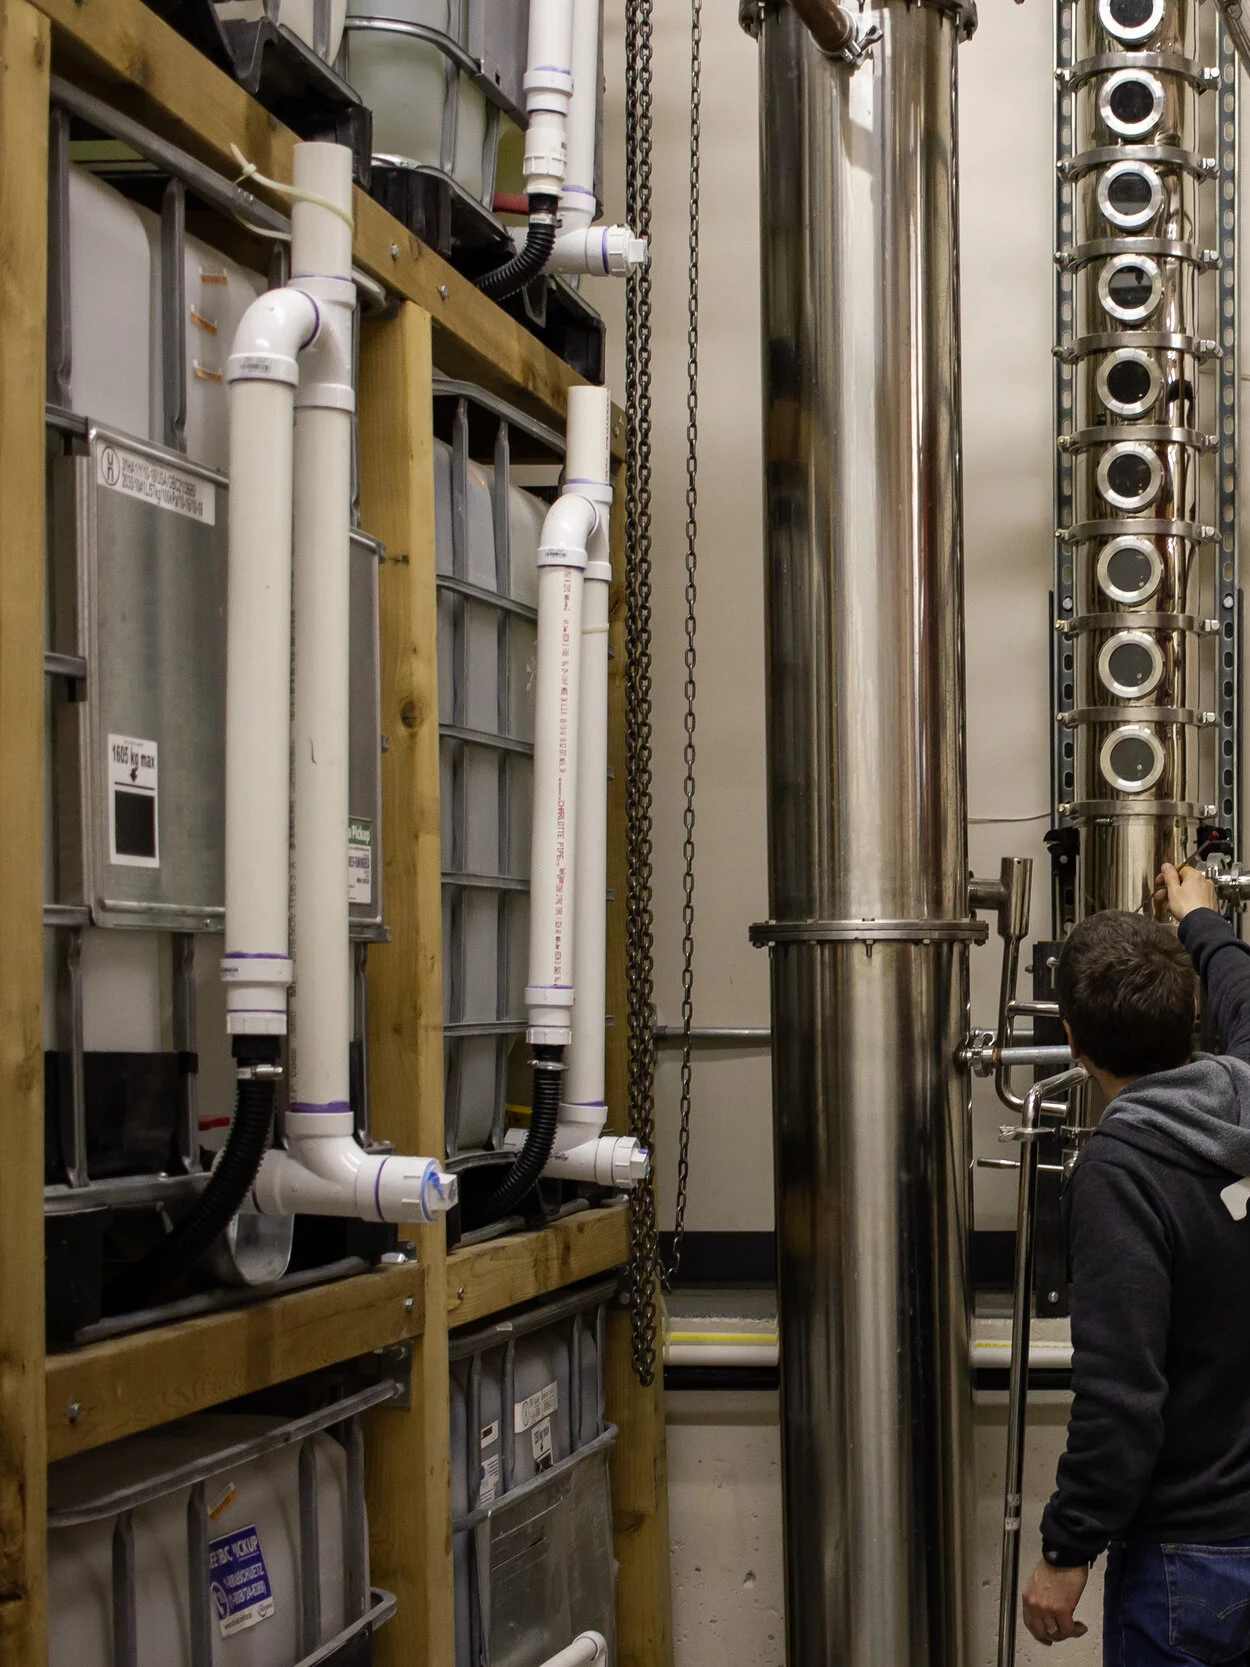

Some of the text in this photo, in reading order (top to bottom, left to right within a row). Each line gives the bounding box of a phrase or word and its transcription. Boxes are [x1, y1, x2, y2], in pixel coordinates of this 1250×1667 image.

[112, 743, 155, 770] 1605 kg max
[557, 800, 565, 839] CHARLOTTE
